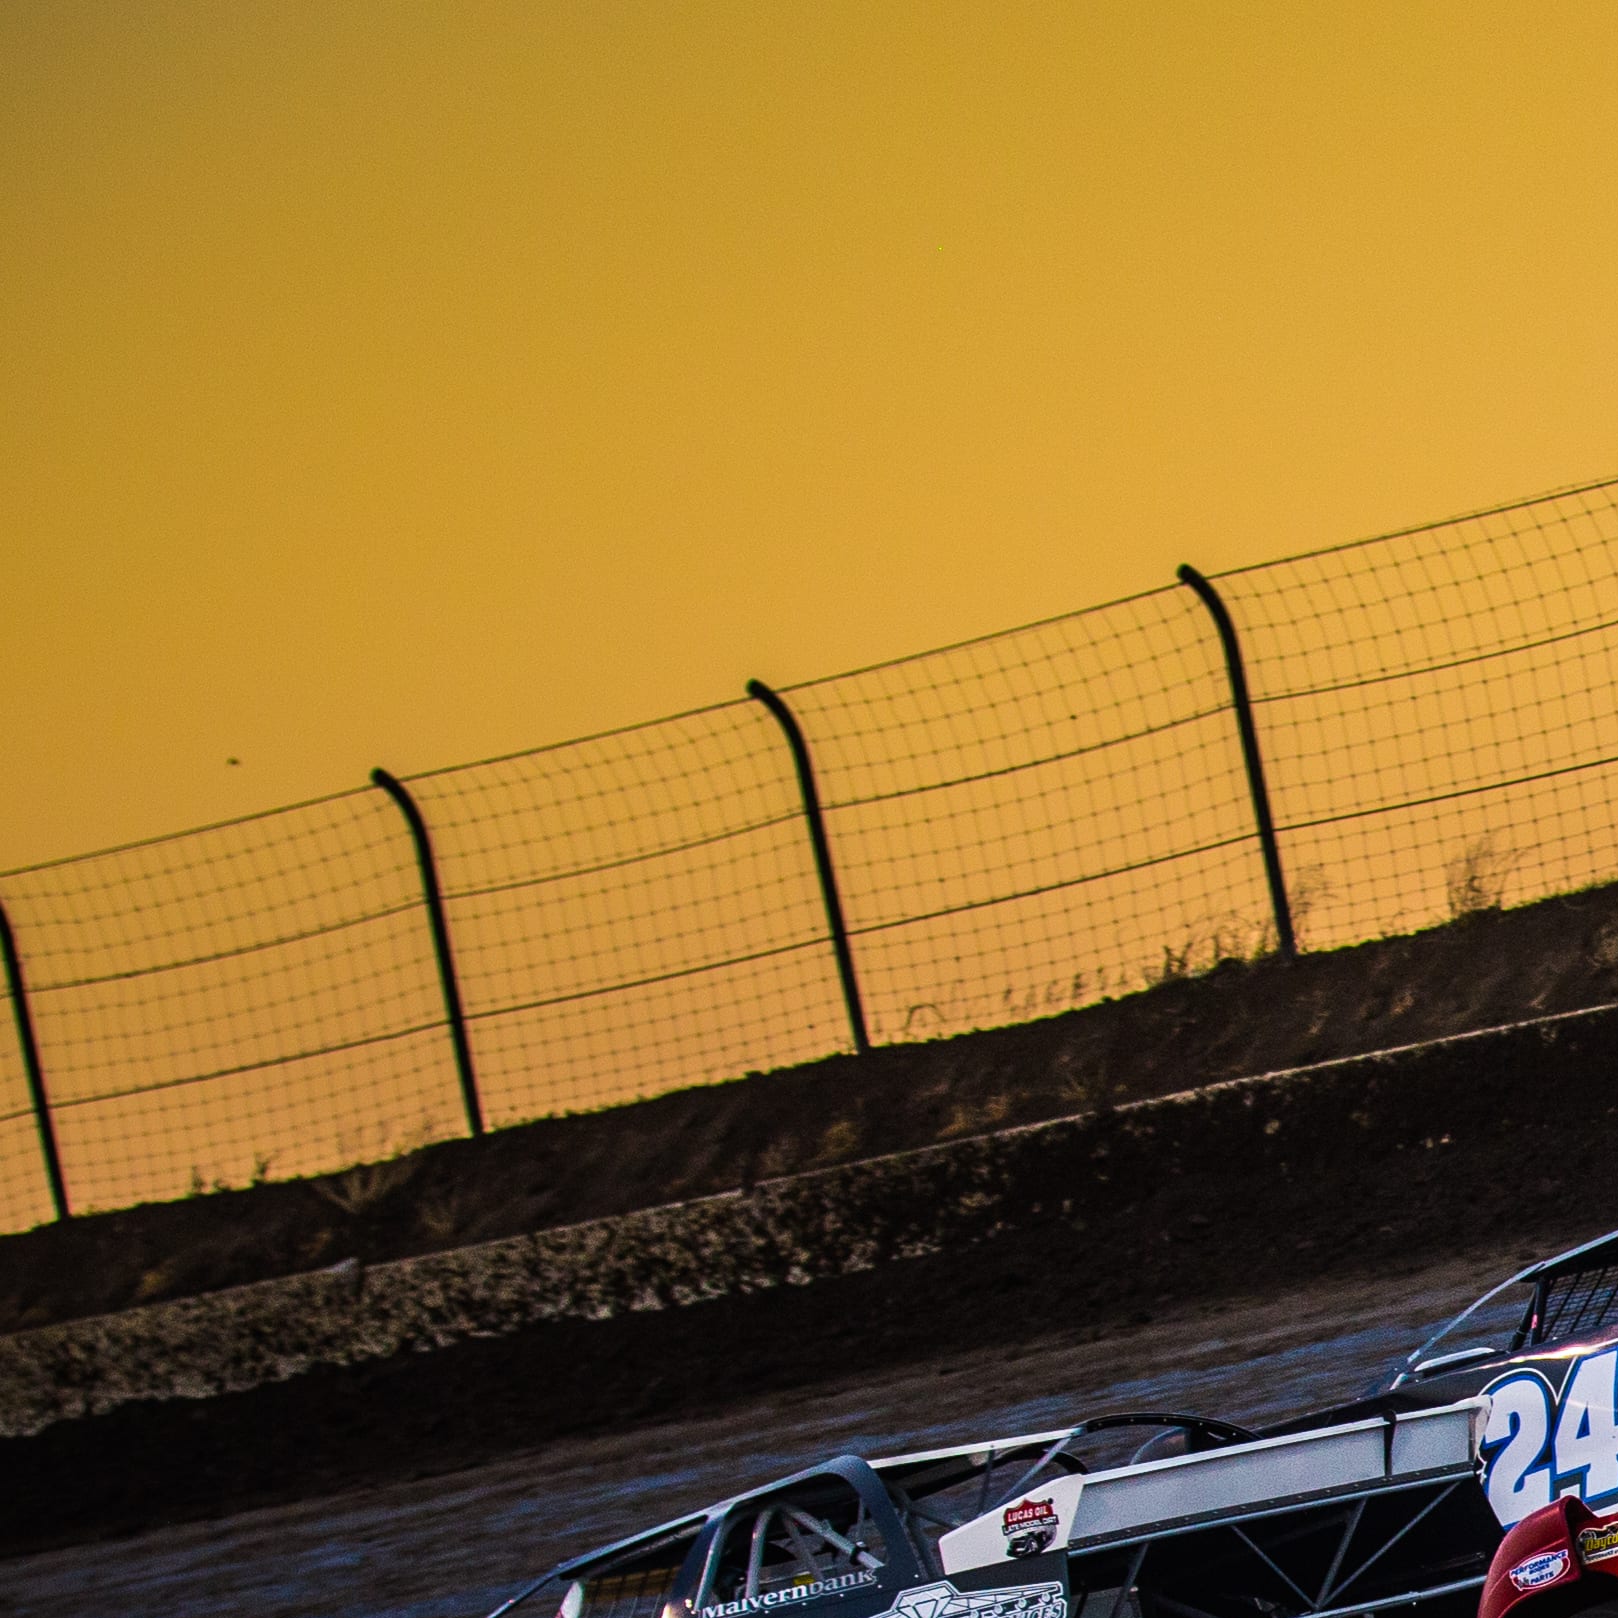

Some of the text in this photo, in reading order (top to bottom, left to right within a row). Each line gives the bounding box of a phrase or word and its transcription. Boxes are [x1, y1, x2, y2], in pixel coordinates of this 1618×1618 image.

[1007, 1504, 1049, 1523] LUCAS OIL
[1510, 1550, 1568, 1577] PERFORMANCE
[1530, 1571, 1554, 1585] PARTS
